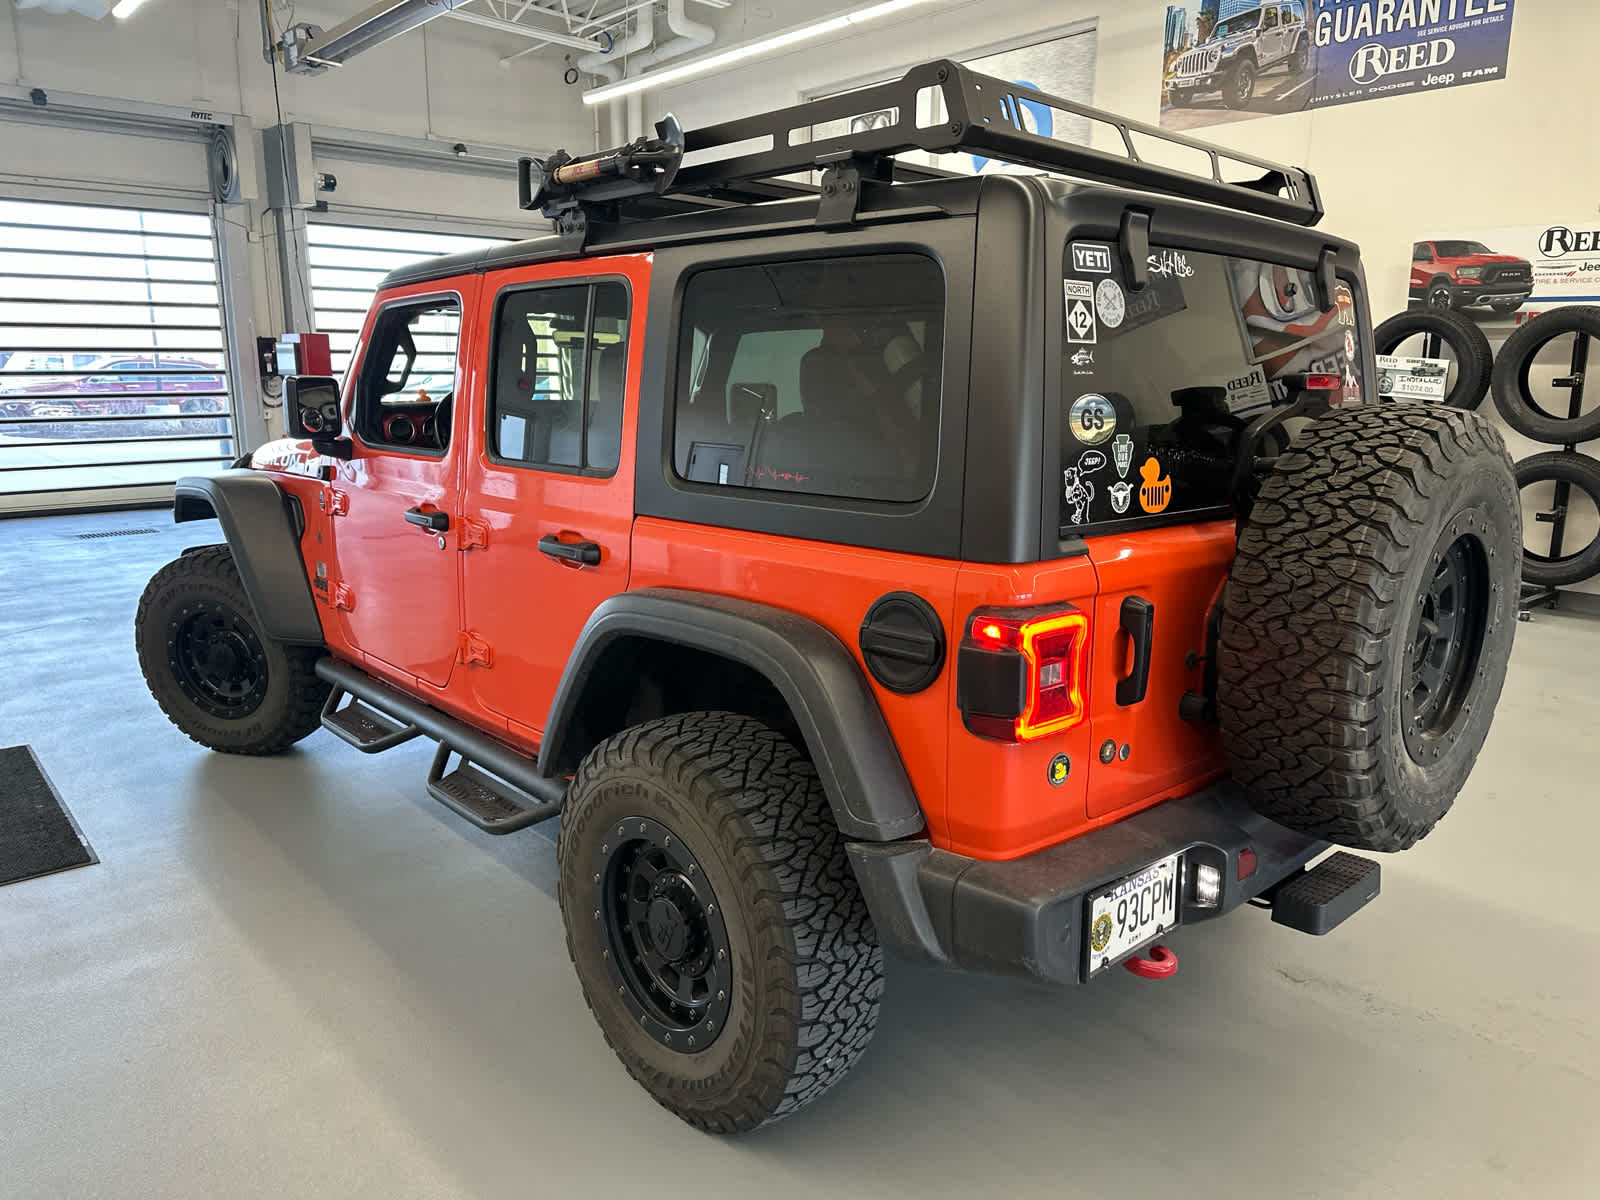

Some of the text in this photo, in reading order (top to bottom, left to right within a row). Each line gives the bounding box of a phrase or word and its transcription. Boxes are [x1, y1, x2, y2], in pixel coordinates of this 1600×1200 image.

[1427, 25, 1448, 35] SERVICE
[1448, 21, 1470, 31] ADVISOR
[1352, 38, 1456, 80] REED
[1309, 66, 1498, 103] CHRYSLER DODGE Jeep RAM
[1075, 249, 1108, 267] YETI
[1067, 286, 1090, 296] NORTH
[1074, 311, 1088, 329] 12
[1110, 868, 1160, 902] KANSAS
[1117, 873, 1174, 939] 93CPM
